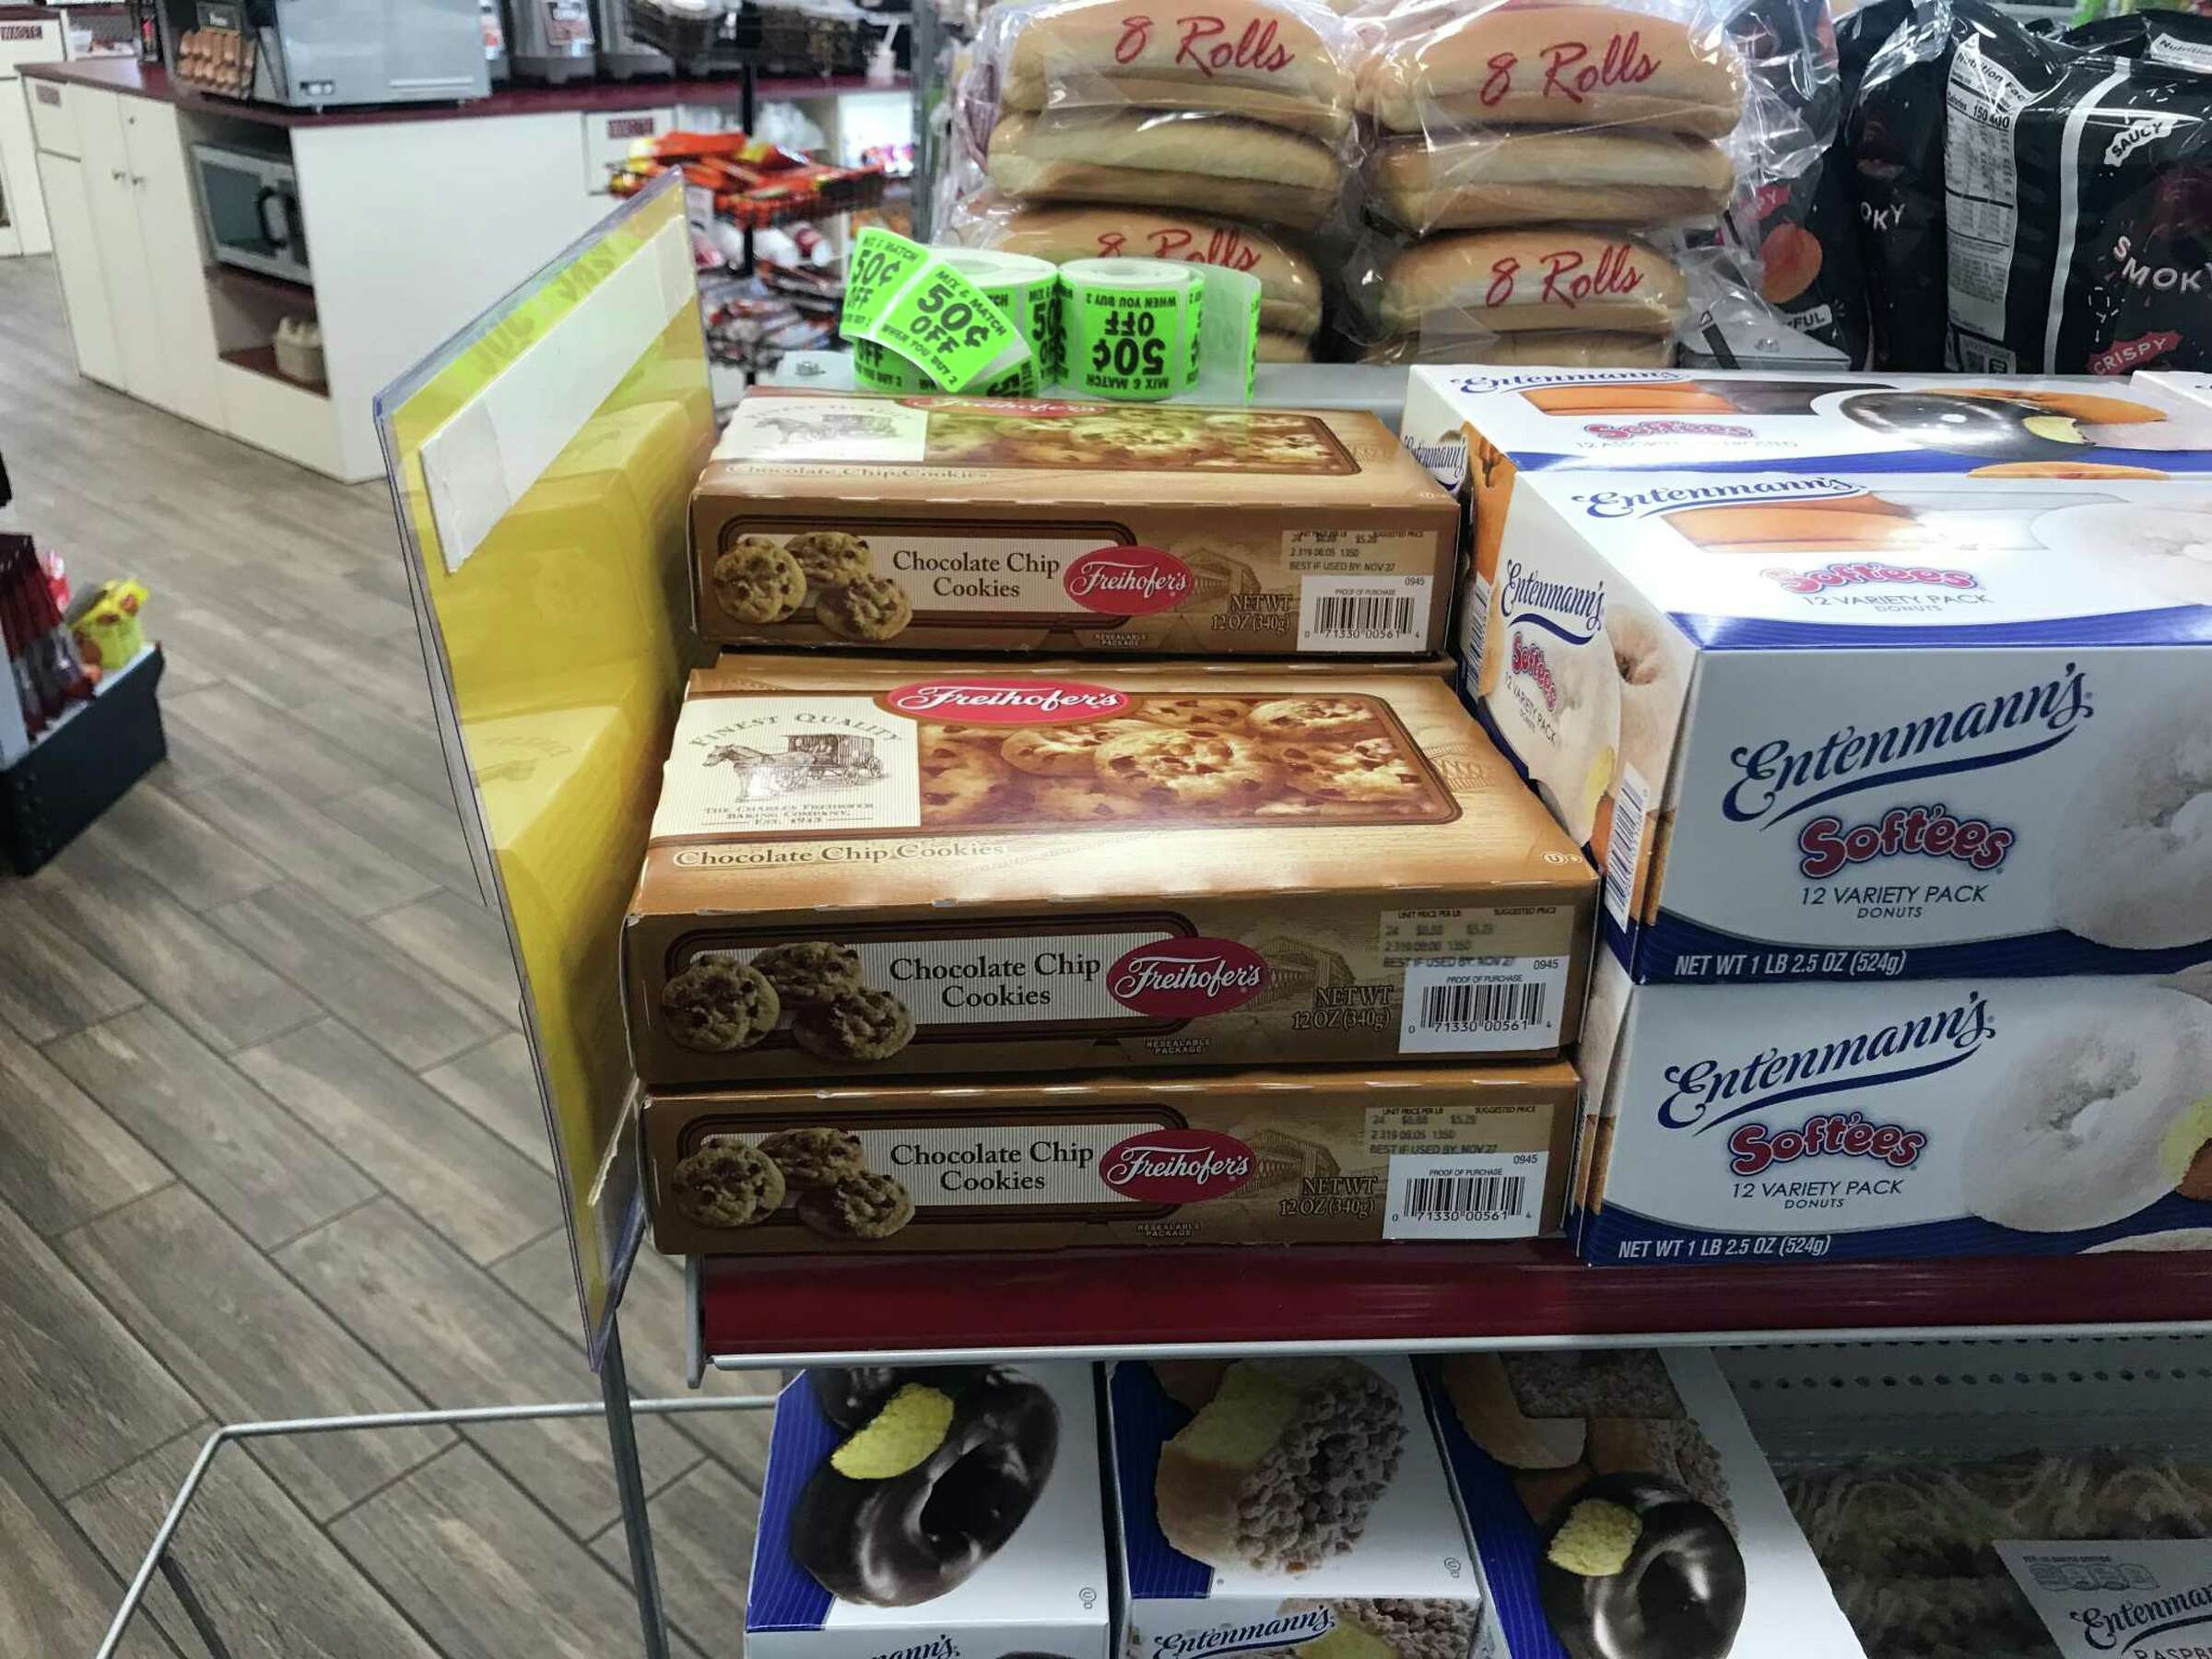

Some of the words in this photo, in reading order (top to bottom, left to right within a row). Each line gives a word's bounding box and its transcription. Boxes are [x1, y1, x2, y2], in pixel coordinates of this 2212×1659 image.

[1114, 16, 1152, 65] 8
[1176, 16, 1296, 78] Rolls
[1479, 52, 1521, 107] 8
[1543, 30, 1662, 104] Rolls
[2112, 121, 2163, 158] SAUCY
[1098, 232, 1123, 259] 8
[1486, 257, 1522, 308] 8
[1540, 245, 1644, 308] Rolls
[935, 271, 959, 291] MIX
[969, 299, 1006, 336] MATCH
[1095, 294, 1115, 307] BUY
[1118, 297, 1141, 309] YOU
[1145, 295, 1176, 309] WHEN
[910, 315, 960, 354] OFF
[1104, 311, 1155, 337] OFF
[910, 339, 932, 358] YOU
[930, 356, 951, 376] BUY
[948, 375, 958, 386] 2
[2093, 337, 2166, 375] CRISPY
[1086, 373, 1129, 390] MATCH
[1146, 376, 1170, 390] MIX
[1571, 474, 1854, 518] Entenmann's
[892, 550, 1000, 572] Chocolate
[1006, 550, 1060, 579] Chip
[933, 576, 1020, 598] Cookies
[1070, 561, 1188, 599] Freihofer's
[1404, 577, 1425, 586] 0945
[1500, 559, 1606, 632] Entenmann's
[1839, 594, 1924, 606] VARIETY
[1930, 593, 1995, 606] PACK
[897, 686, 1119, 711] Freihofer's
[794, 712, 902, 742] QUALITY
[1723, 663, 2094, 822] Entenmann's
[674, 848, 813, 866] Chocolate
[820, 845, 890, 865] Chip
[897, 842, 1005, 859] Cookies
[1801, 887, 1826, 905] 12
[1833, 885, 1919, 905] VARIETY
[1925, 884, 1989, 904] PACK
[1857, 907, 1924, 920] DONUTS
[890, 955, 1026, 982] Chocolate
[1034, 952, 1100, 983] Chip
[1533, 959, 1559, 970] 0945
[1675, 955, 1712, 977] NET
[1715, 954, 1749, 976] WT
[1751, 955, 1759, 975] 1
[1764, 954, 1788, 975] LB
[1792, 953, 1818, 973] 2.5
[1822, 953, 1847, 973] OZ
[1849, 950, 1907, 976] (524g)
[1114, 955, 1262, 998] Freihofer's
[1446, 975, 1472, 983] PROOF
[1484, 974, 1524, 982] PURCHASE
[941, 985, 1051, 1008] Cookies
[1317, 986, 1357, 1006] NET
[1359, 985, 1394, 1006] WT
[1292, 1010, 1312, 1030] 12
[1313, 1010, 1341, 1029] OZ
[1343, 1008, 1394, 1031] (340g)
[1435, 1020, 1477, 1032] 71330
[1485, 1020, 1527, 1032] 00561
[1657, 990, 1995, 1130] Entenmann's
[890, 1143, 1021, 1167] Chocolate
[1030, 1141, 1094, 1169] Chip
[1107, 1147, 1248, 1185] Freihofer's
[1512, 1155, 1538, 1165] 0945
[940, 1171, 1046, 1193] Cookies
[1430, 1168, 1452, 1176] PROOF
[1302, 1177, 1340, 1195] NET
[1341, 1176, 1379, 1195] WT
[1733, 1182, 1755, 1198] 12
[1762, 1181, 1843, 1198] VARIETY
[1844, 1179, 1903, 1196] PACK
[1280, 1199, 1297, 1217] 12
[1300, 1199, 1326, 1216] OZ
[1327, 1197, 1376, 1220] (340g)
[1783, 1198, 1844, 1210] DONUTS
[1418, 1211, 1459, 1222] 71330
[1465, 1211, 1508, 1221] 00561
[1618, 1241, 1653, 1259] NET
[1655, 1240, 1686, 1259] WT
[1688, 1240, 1695, 1258] 1
[1700, 1239, 1723, 1256] LB
[1726, 1238, 1751, 1255] 2.5
[1753, 1237, 1778, 1255] OZ
[1778, 1234, 1831, 1258] (524g)
[1153, 1605, 1335, 1659] Entenmann's
